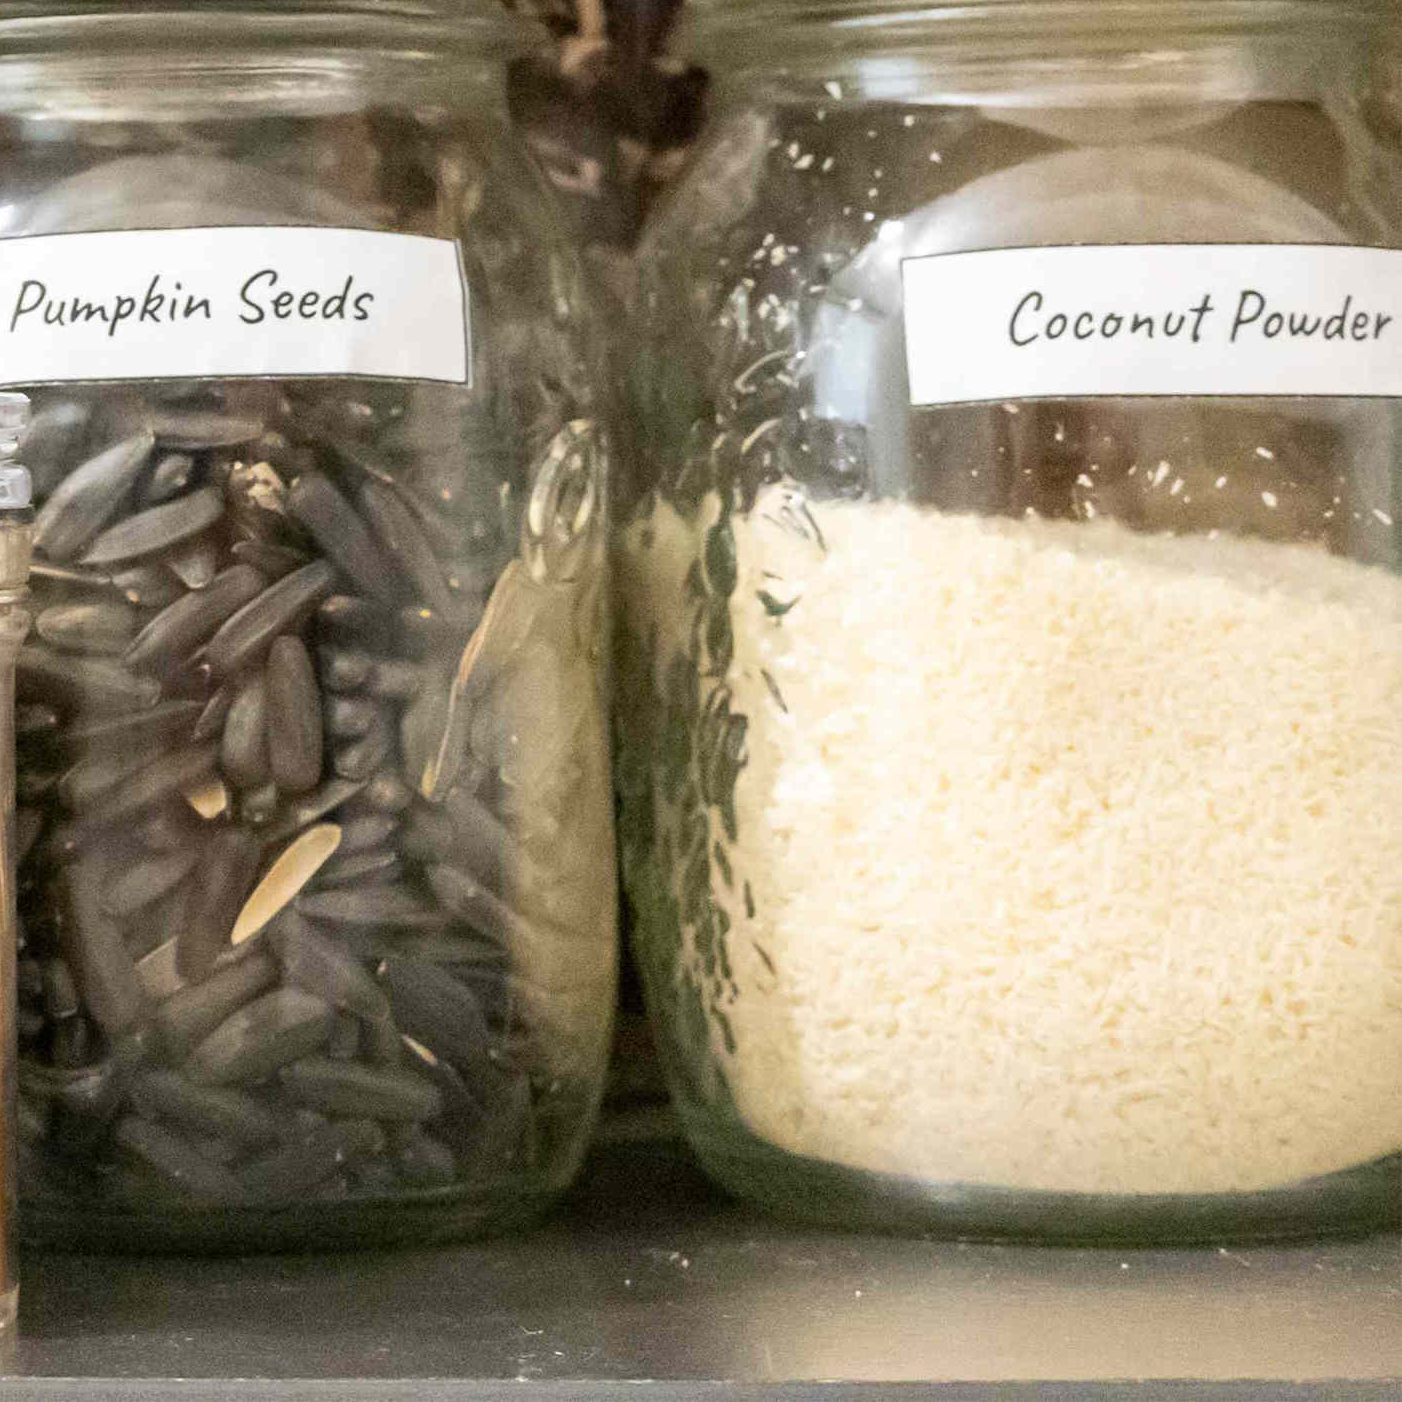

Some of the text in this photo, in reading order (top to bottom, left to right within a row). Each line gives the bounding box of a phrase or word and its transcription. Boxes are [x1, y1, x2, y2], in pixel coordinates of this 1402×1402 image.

[11, 270, 374, 336] Pumpkin Seeds
[1009, 290, 1392, 346] Coconut Powder
